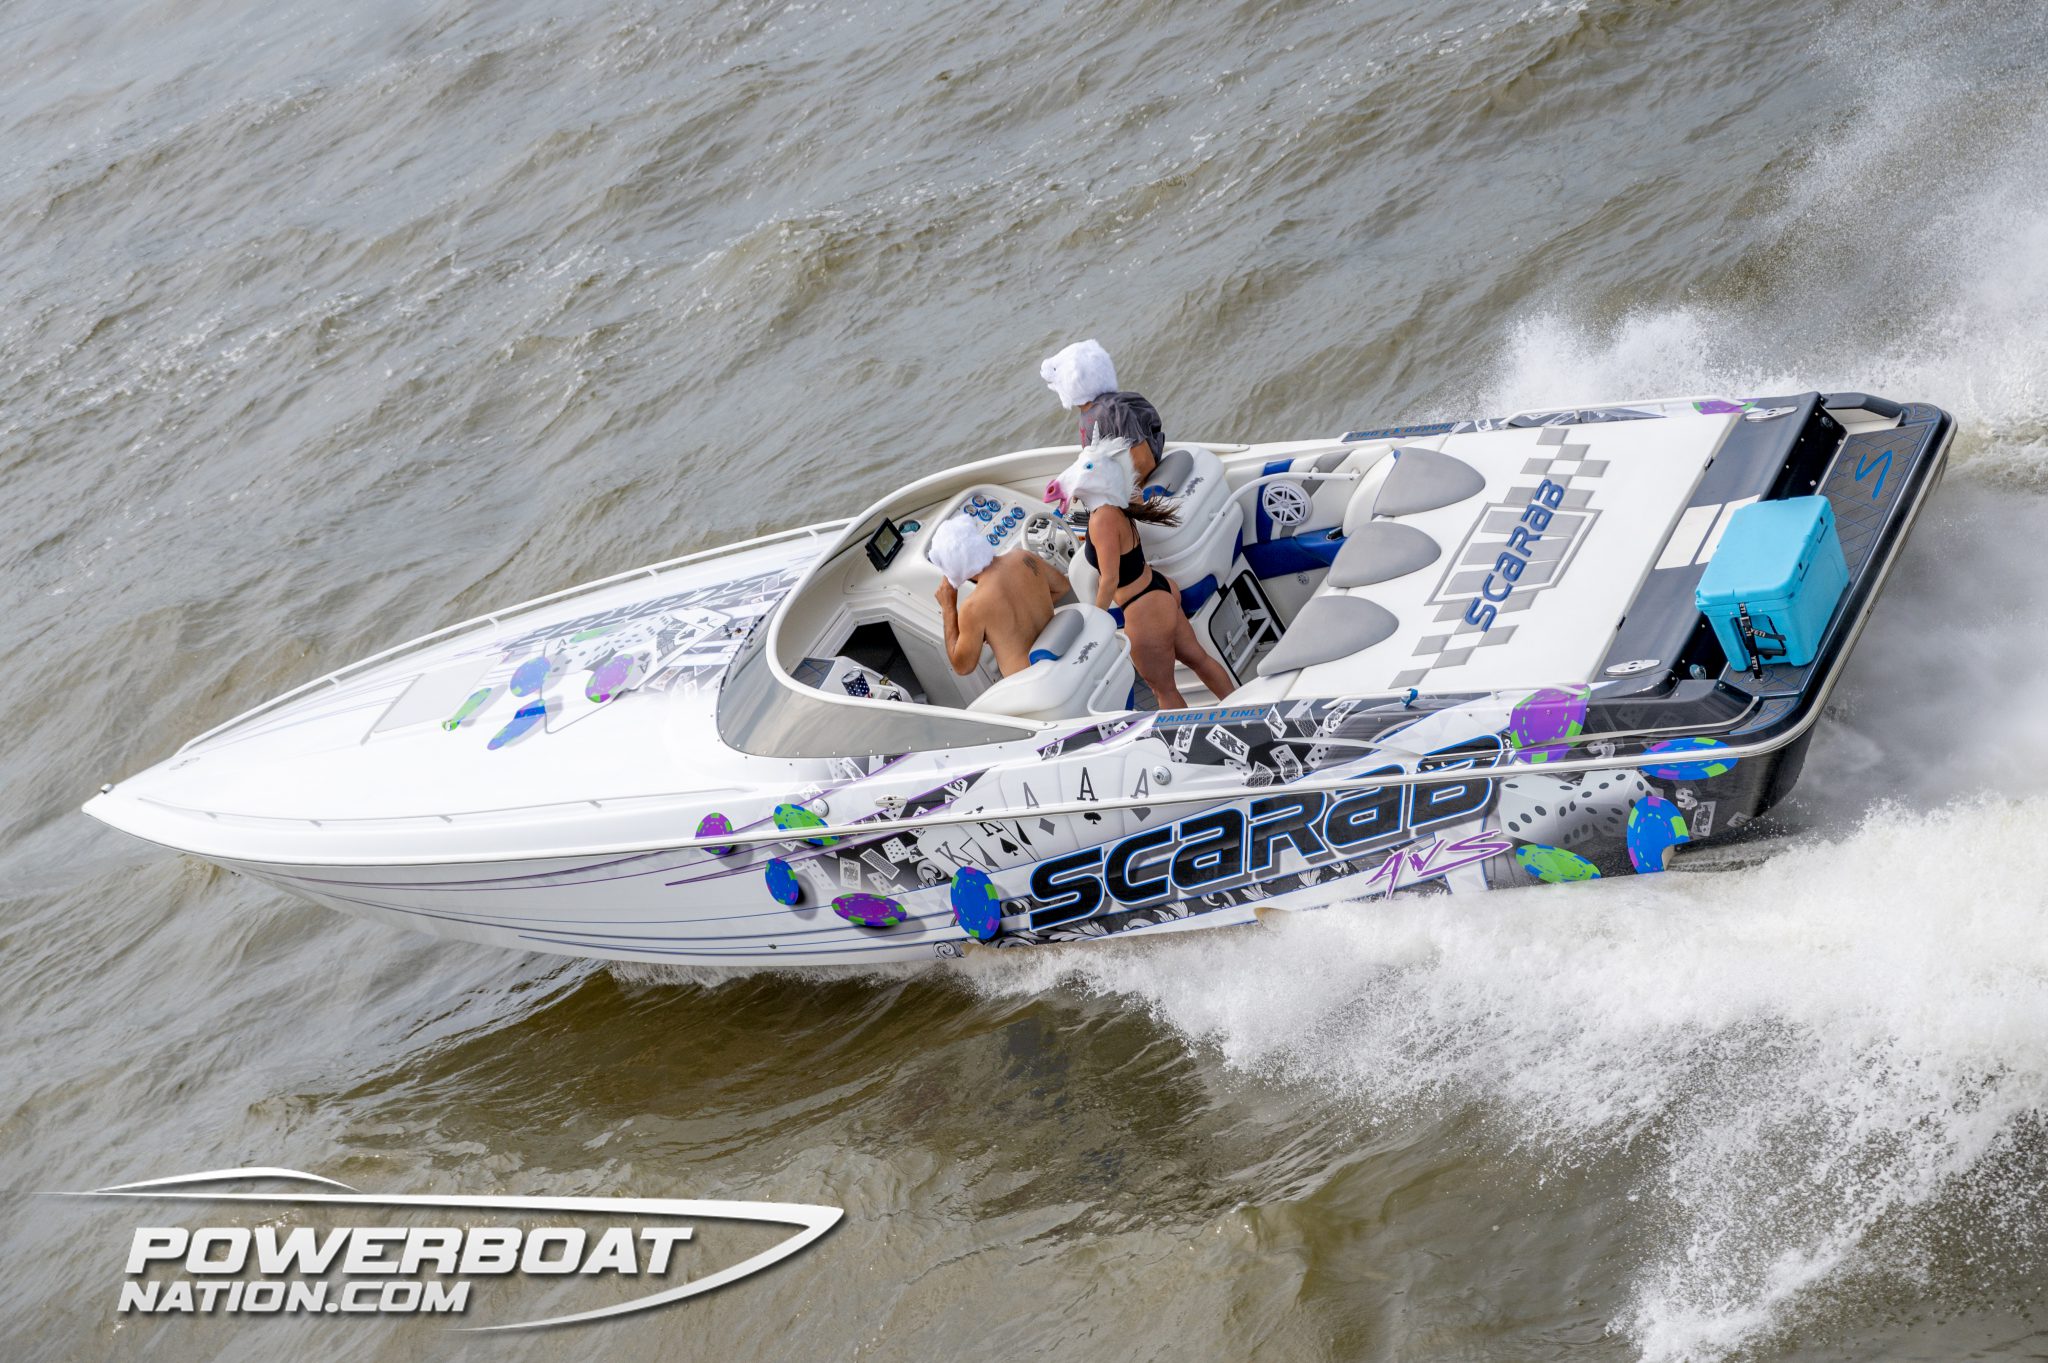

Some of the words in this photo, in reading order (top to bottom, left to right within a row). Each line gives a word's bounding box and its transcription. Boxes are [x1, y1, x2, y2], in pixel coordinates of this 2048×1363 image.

[1155, 712, 1204, 724] NAKED
[1230, 708, 1267, 719] ONLY
[1076, 766, 1099, 802] A
[1130, 767, 1150, 799] A
